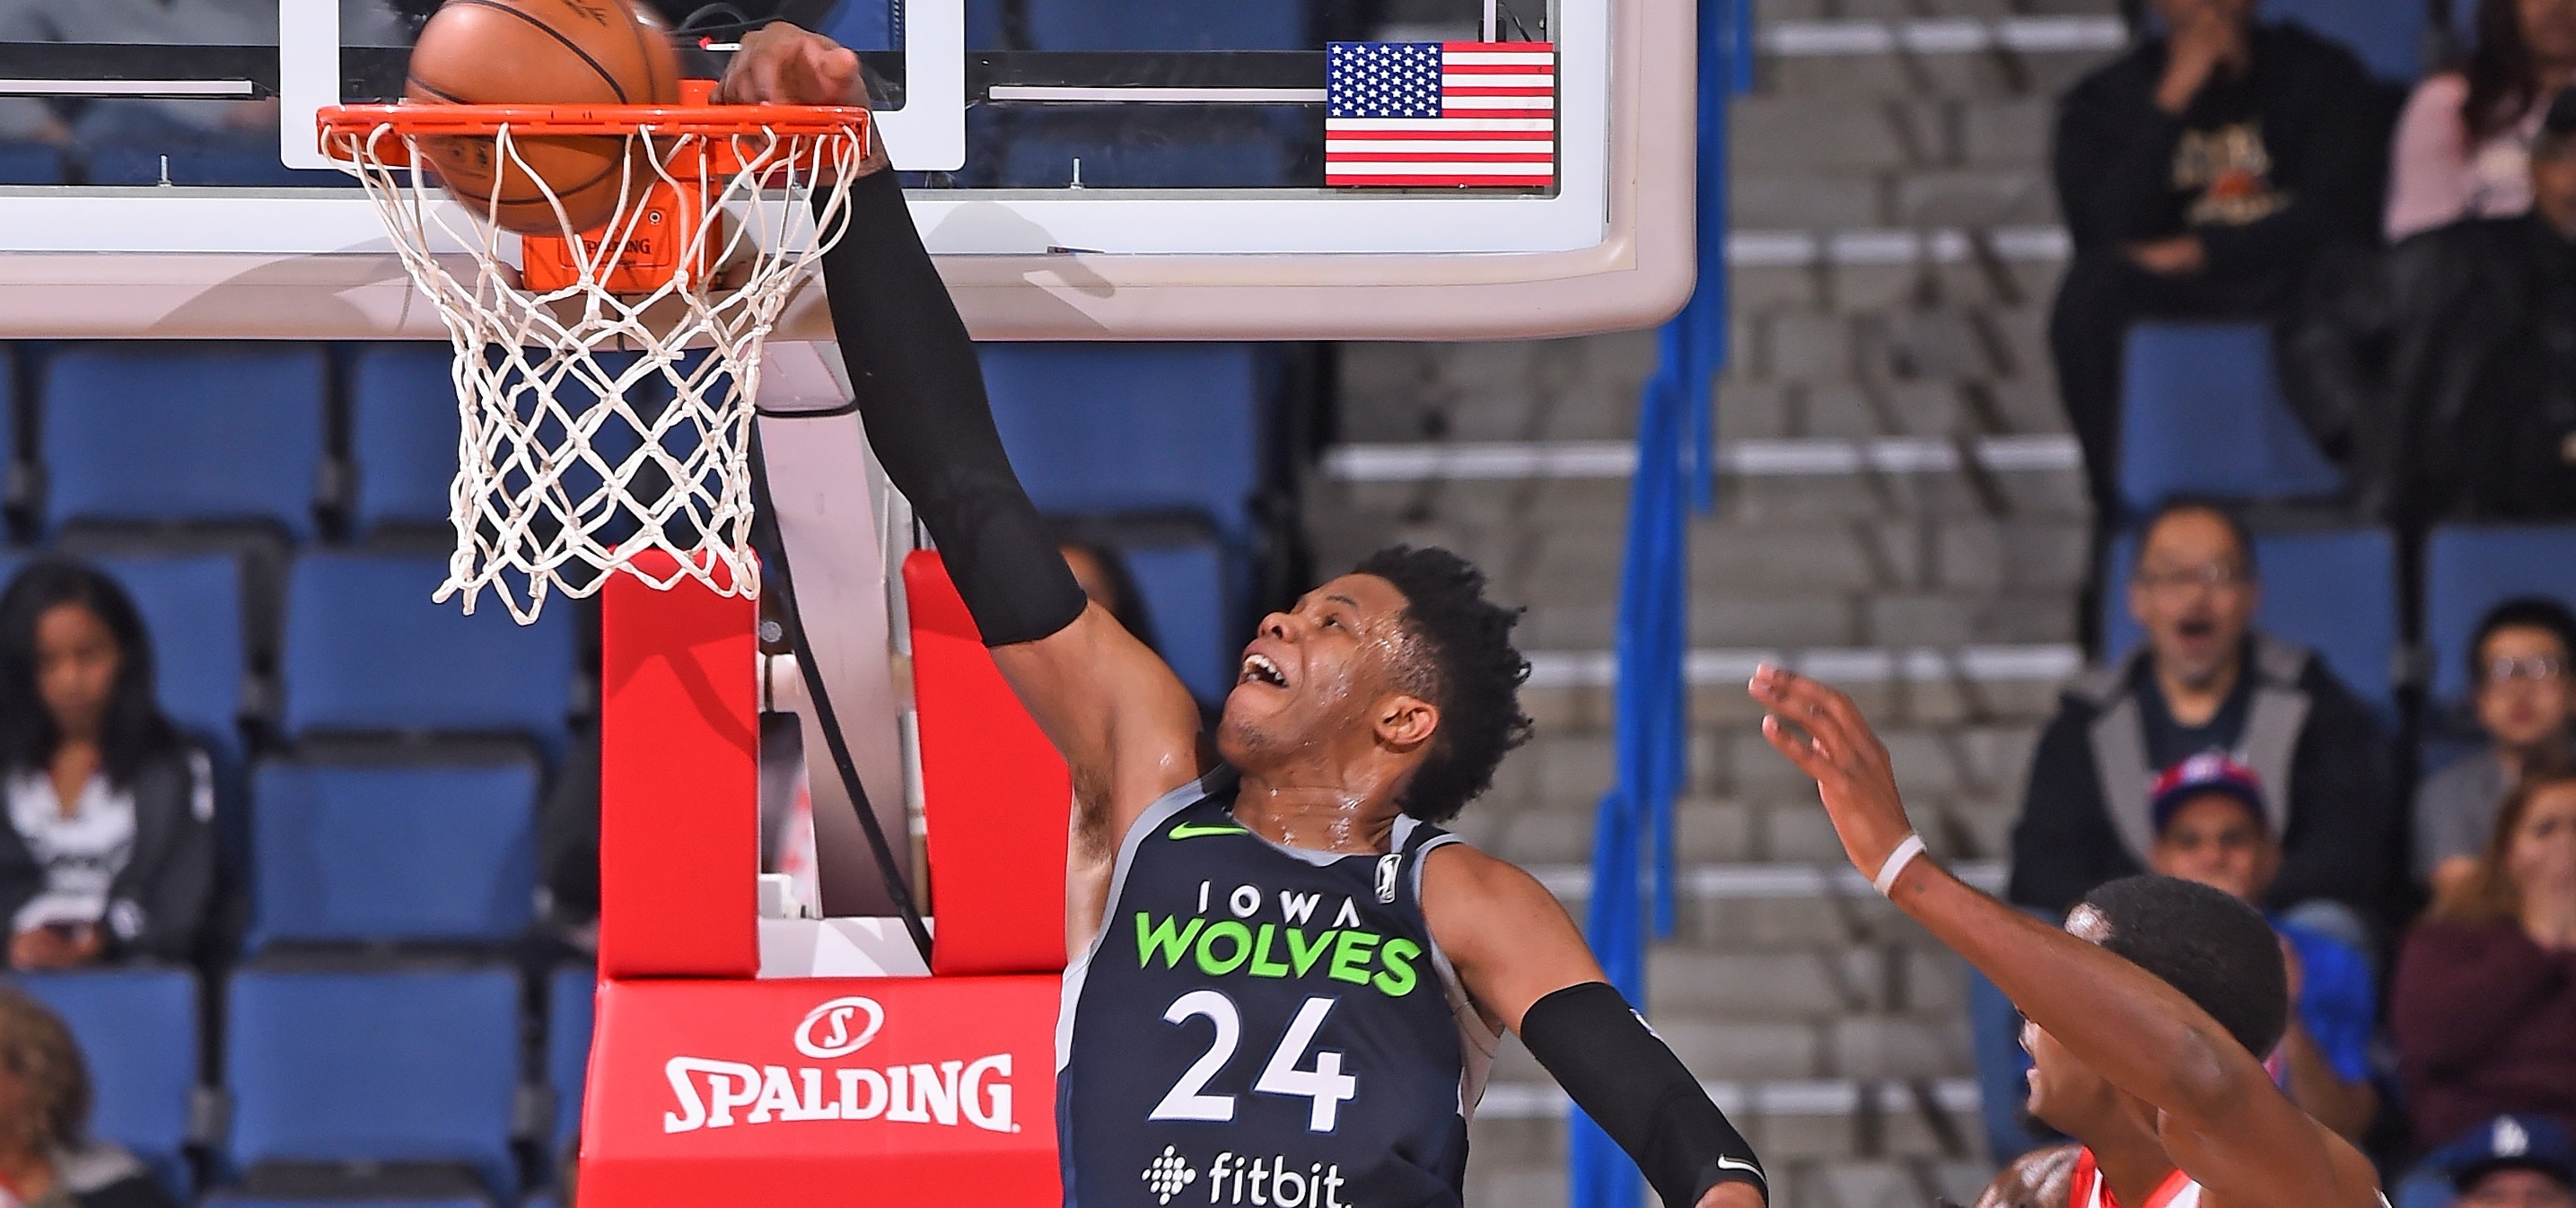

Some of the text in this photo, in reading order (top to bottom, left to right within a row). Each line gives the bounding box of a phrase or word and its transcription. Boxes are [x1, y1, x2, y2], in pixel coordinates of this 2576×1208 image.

[1196, 880, 1361, 928] IOWA
[1135, 912, 1422, 996] WOLVES
[664, 1053, 1012, 1134] SPALDING
[1147, 990, 1357, 1133] 24
